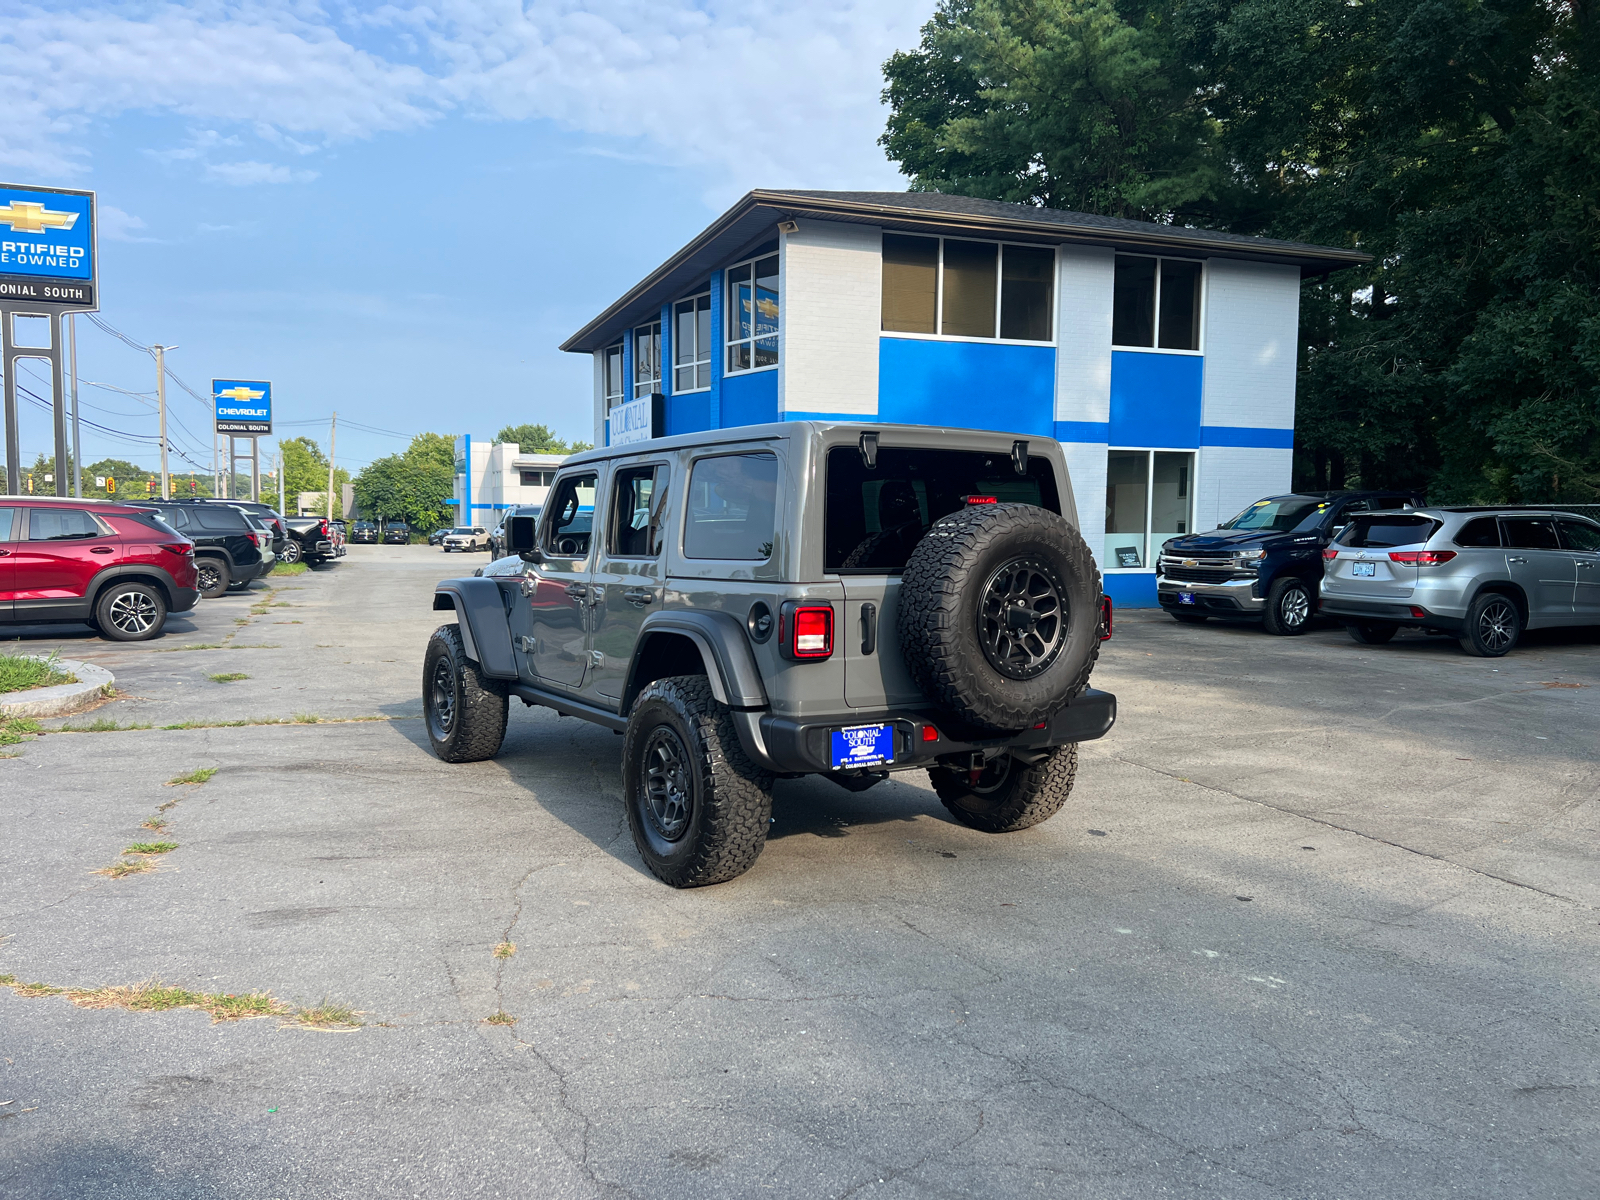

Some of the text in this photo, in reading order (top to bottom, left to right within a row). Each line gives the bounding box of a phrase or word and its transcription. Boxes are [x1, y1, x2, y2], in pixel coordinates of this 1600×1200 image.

[2, 241, 84, 257] RTIFIED
[1, 253, 79, 267] E-OWNED
[0, 283, 83, 298] ONIAL SOUTH
[218, 408, 267, 416] CHEVROLET
[612, 402, 647, 436] COLONIAL
[843, 729, 881, 740] COLONIAL
[849, 736, 875, 747] SOUTH
